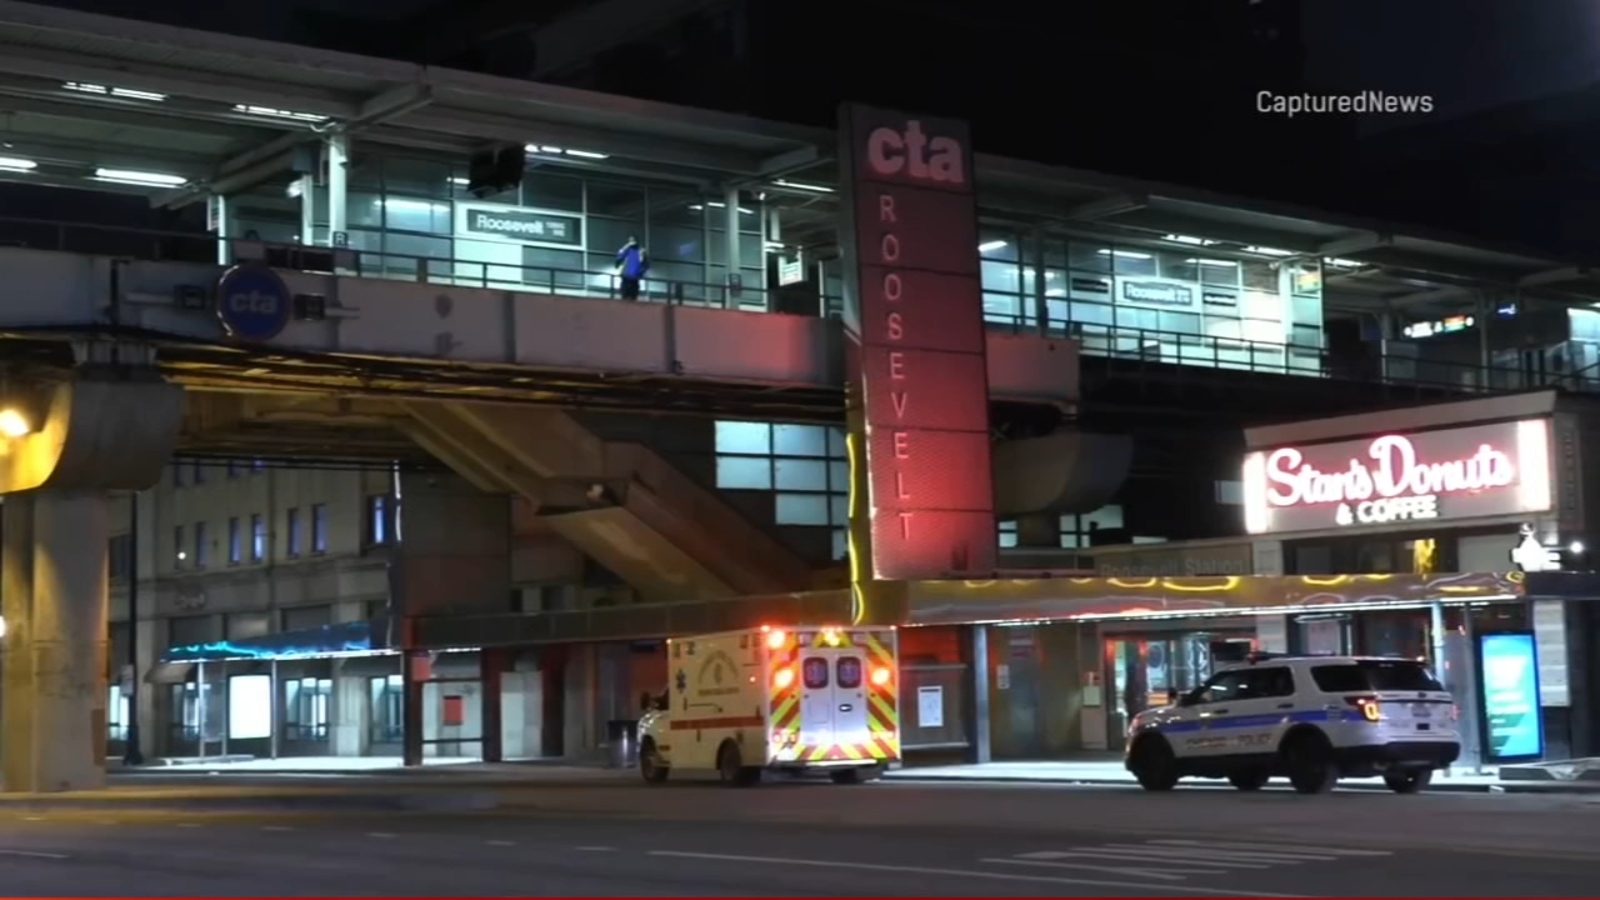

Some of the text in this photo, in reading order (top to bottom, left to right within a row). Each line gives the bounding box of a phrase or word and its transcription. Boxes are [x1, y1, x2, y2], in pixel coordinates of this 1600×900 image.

[868, 120, 963, 183] cta
[476, 214, 543, 235] Roosevelt
[229, 290, 278, 314] cta
[879, 194, 912, 541] ROOSEVELT
[1267, 434, 1513, 506] Stan's Donuts
[1336, 494, 1438, 525] & COFFEE
[1184, 557, 1244, 577] Station
